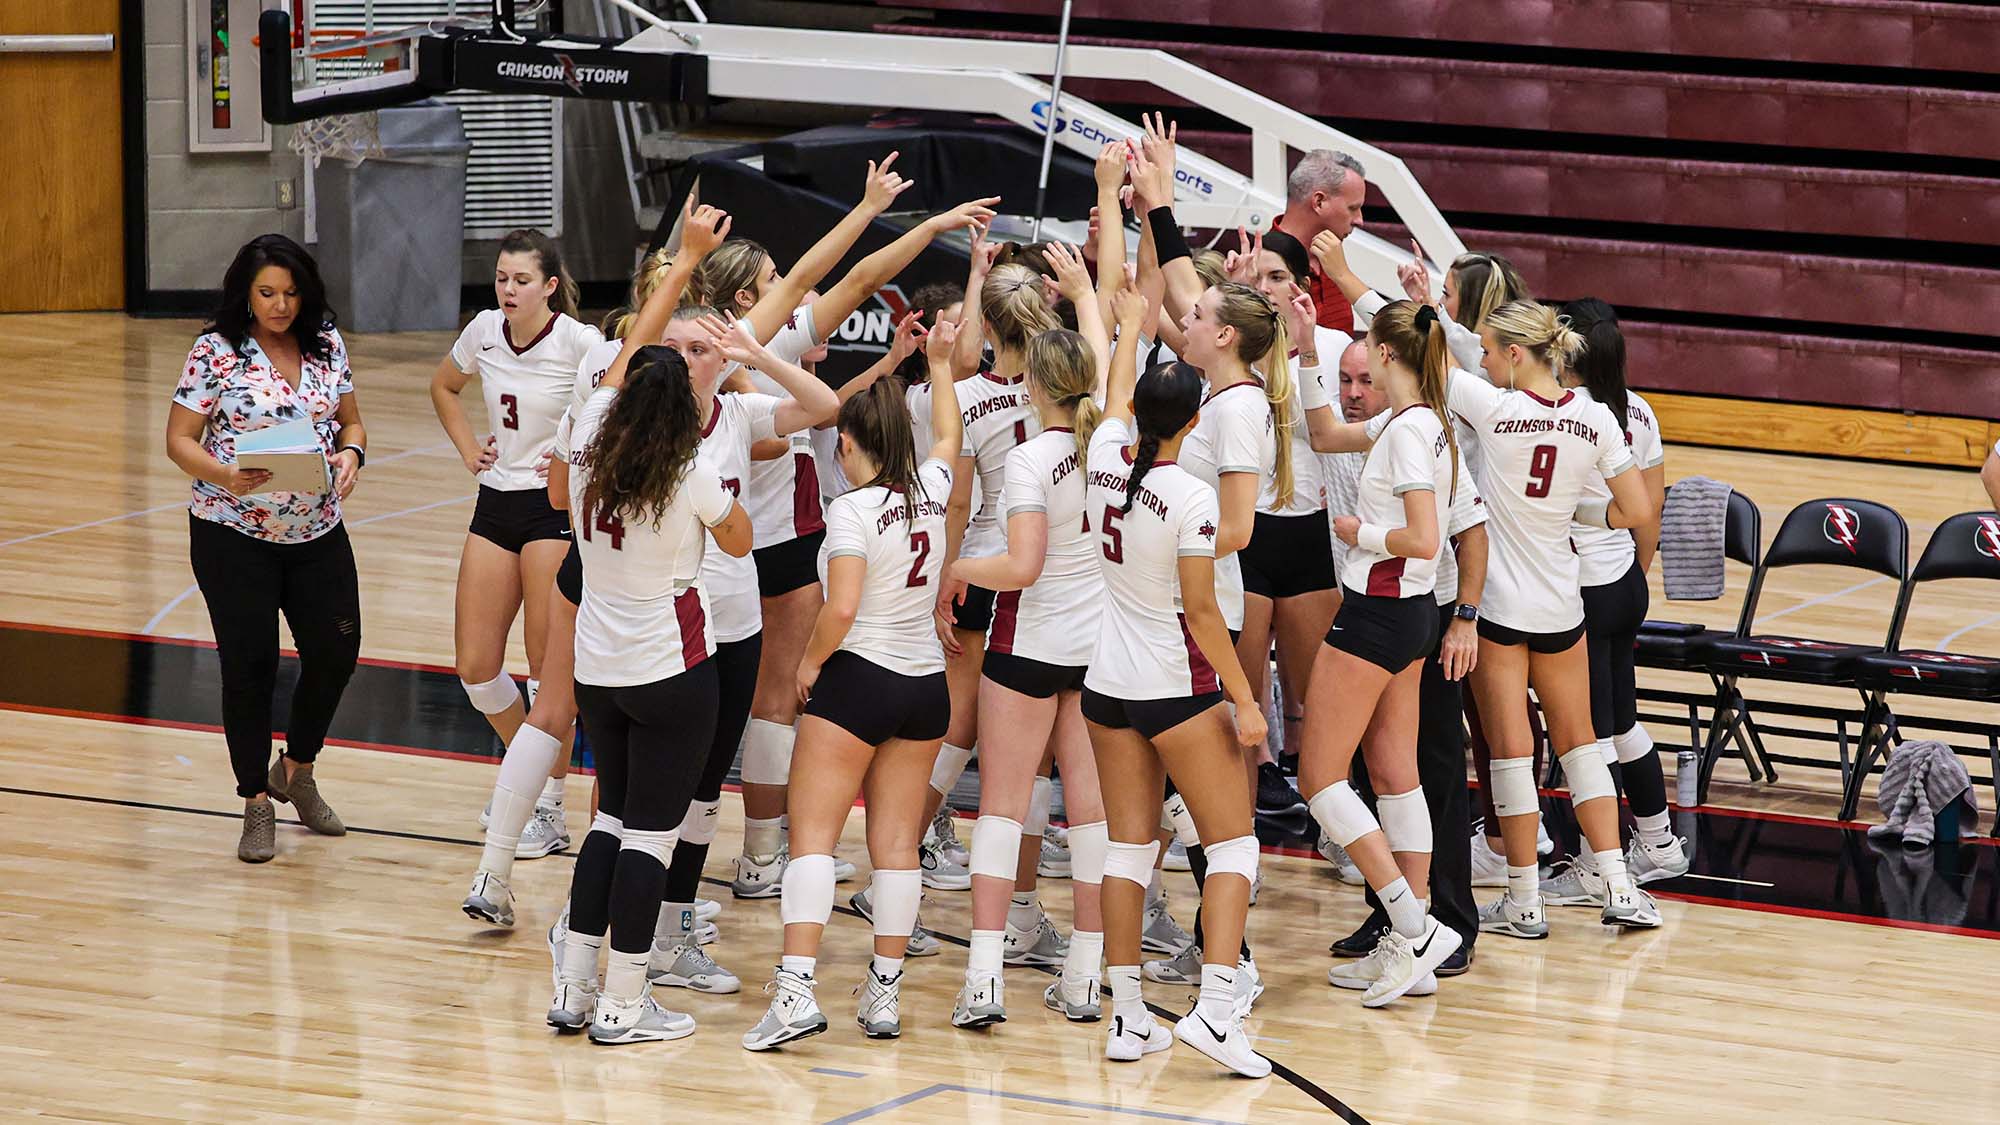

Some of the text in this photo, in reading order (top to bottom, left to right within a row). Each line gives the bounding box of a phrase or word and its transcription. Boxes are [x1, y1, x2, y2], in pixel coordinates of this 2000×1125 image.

[497, 61, 629, 84] CRIMSON STORM
[1070, 119, 1120, 144] Sch
[1175, 169, 1213, 194] orts
[829, 309, 891, 343] ON
[501, 394, 519, 430] 3
[962, 394, 1018, 427] CRIMSON
[1494, 418, 1598, 447] CRIMSON STORM
[1525, 444, 1557, 498] 9
[1101, 504, 1124, 564] 5
[905, 531, 930, 588] 2
